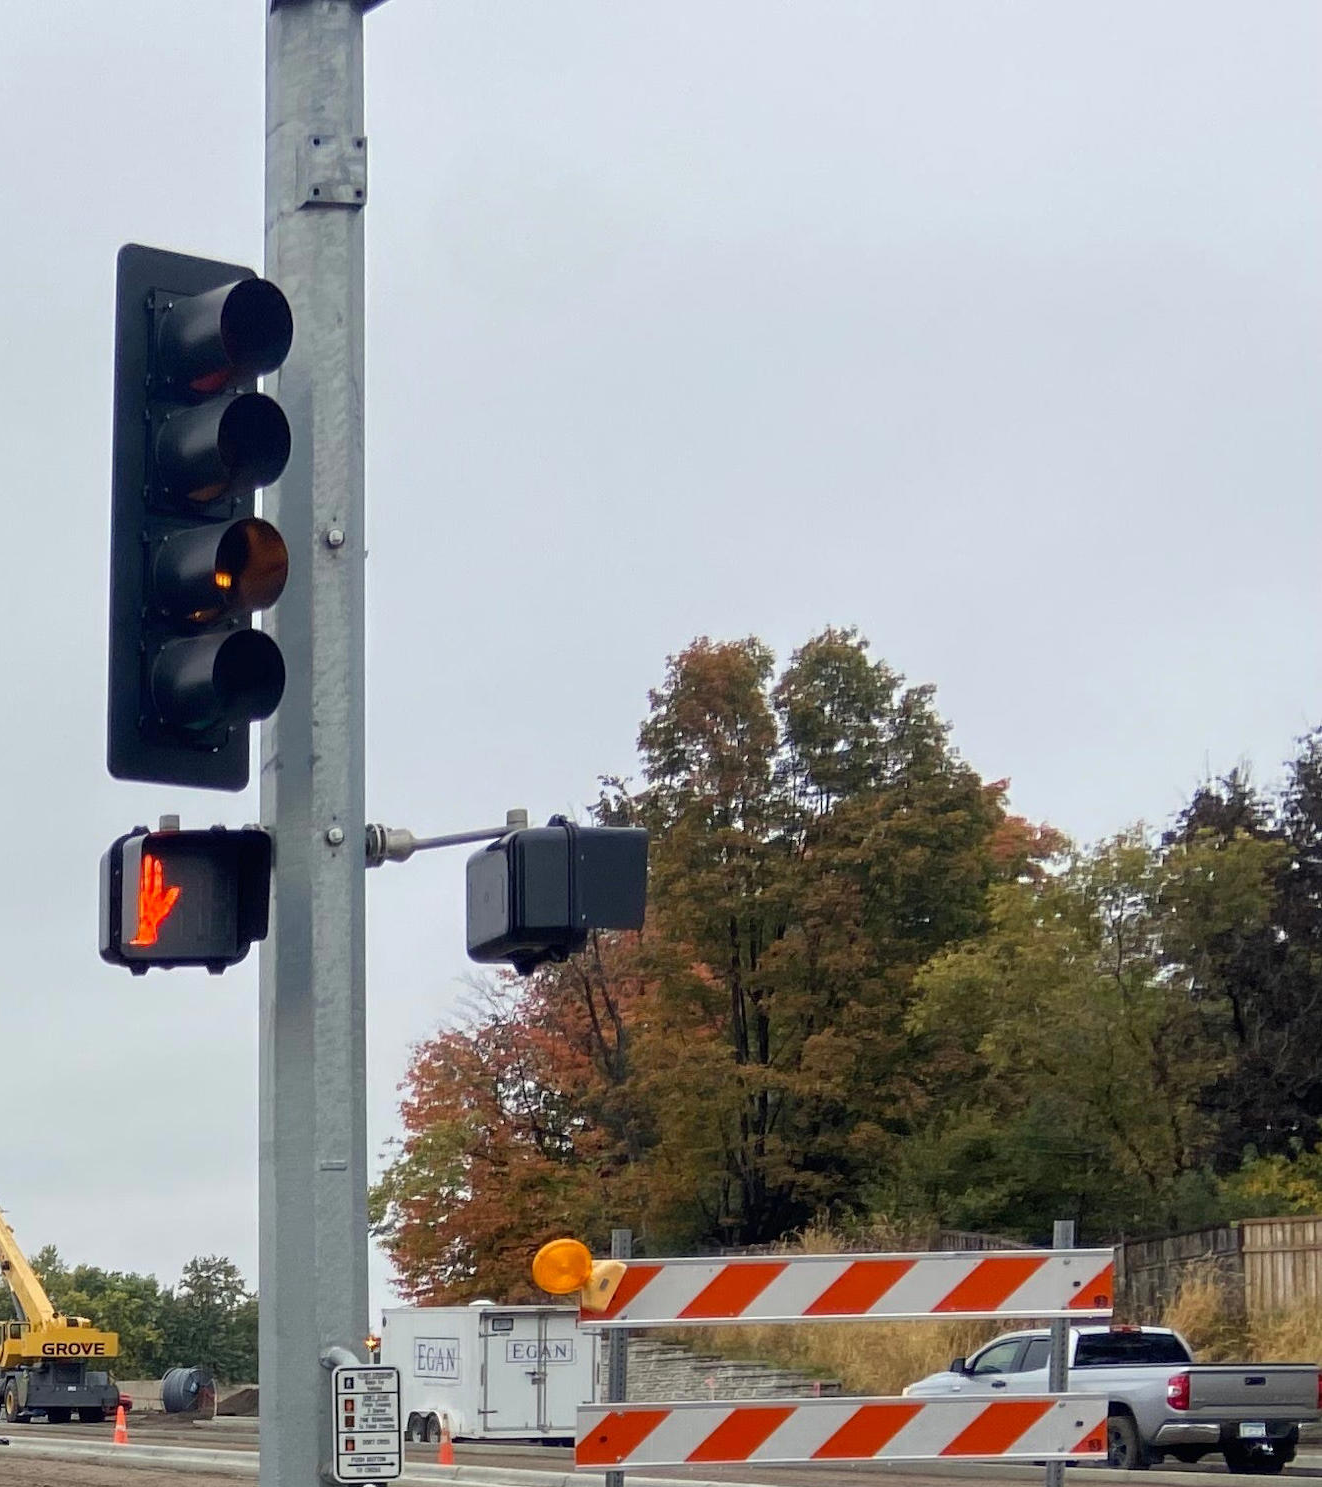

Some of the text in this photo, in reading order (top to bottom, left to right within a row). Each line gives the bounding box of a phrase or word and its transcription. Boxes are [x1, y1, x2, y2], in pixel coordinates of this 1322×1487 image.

[41, 1342, 105, 1355] GROVE
[512, 1343, 567, 1360] EGAN
[417, 1343, 456, 1372] EGAN
